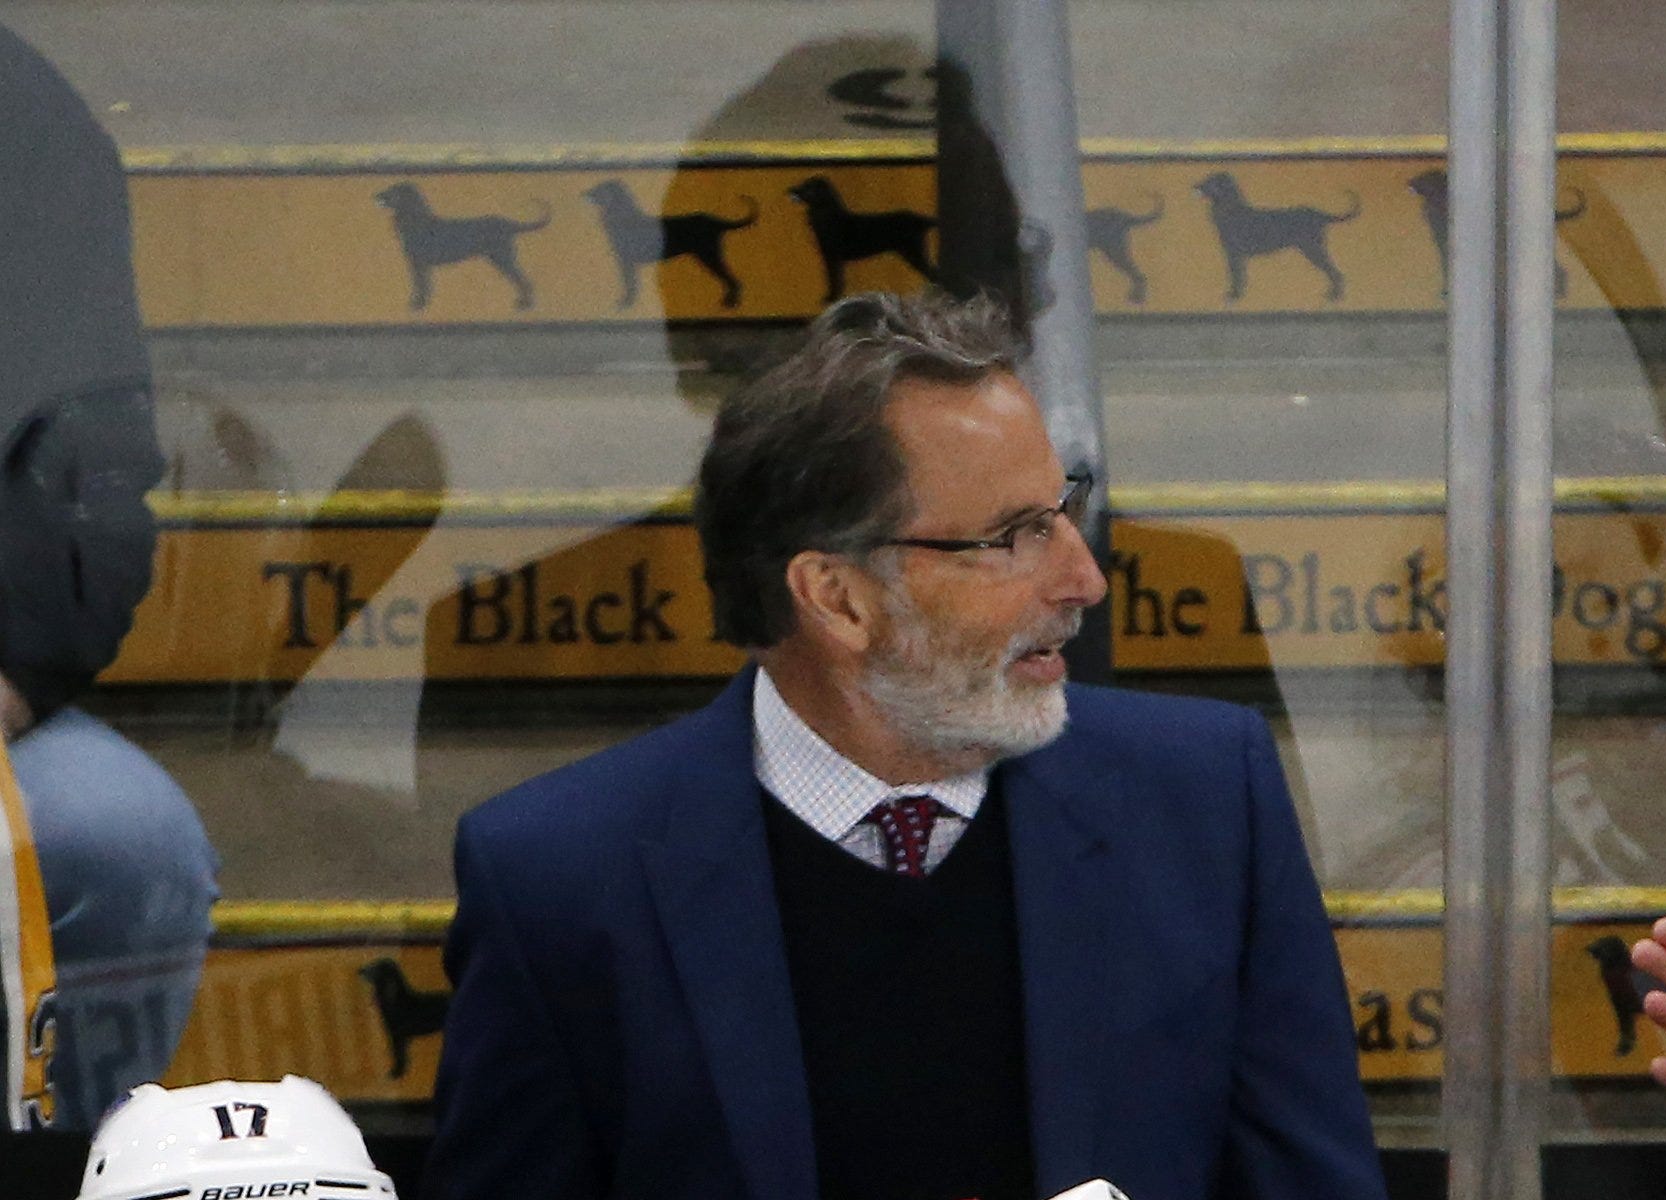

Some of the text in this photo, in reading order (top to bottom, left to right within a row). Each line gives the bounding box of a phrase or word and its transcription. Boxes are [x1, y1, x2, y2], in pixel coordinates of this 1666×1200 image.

[262, 558, 422, 650] The
[454, 557, 678, 647] Black
[1241, 548, 1449, 637] Black
[211, 1102, 268, 1140] 17
